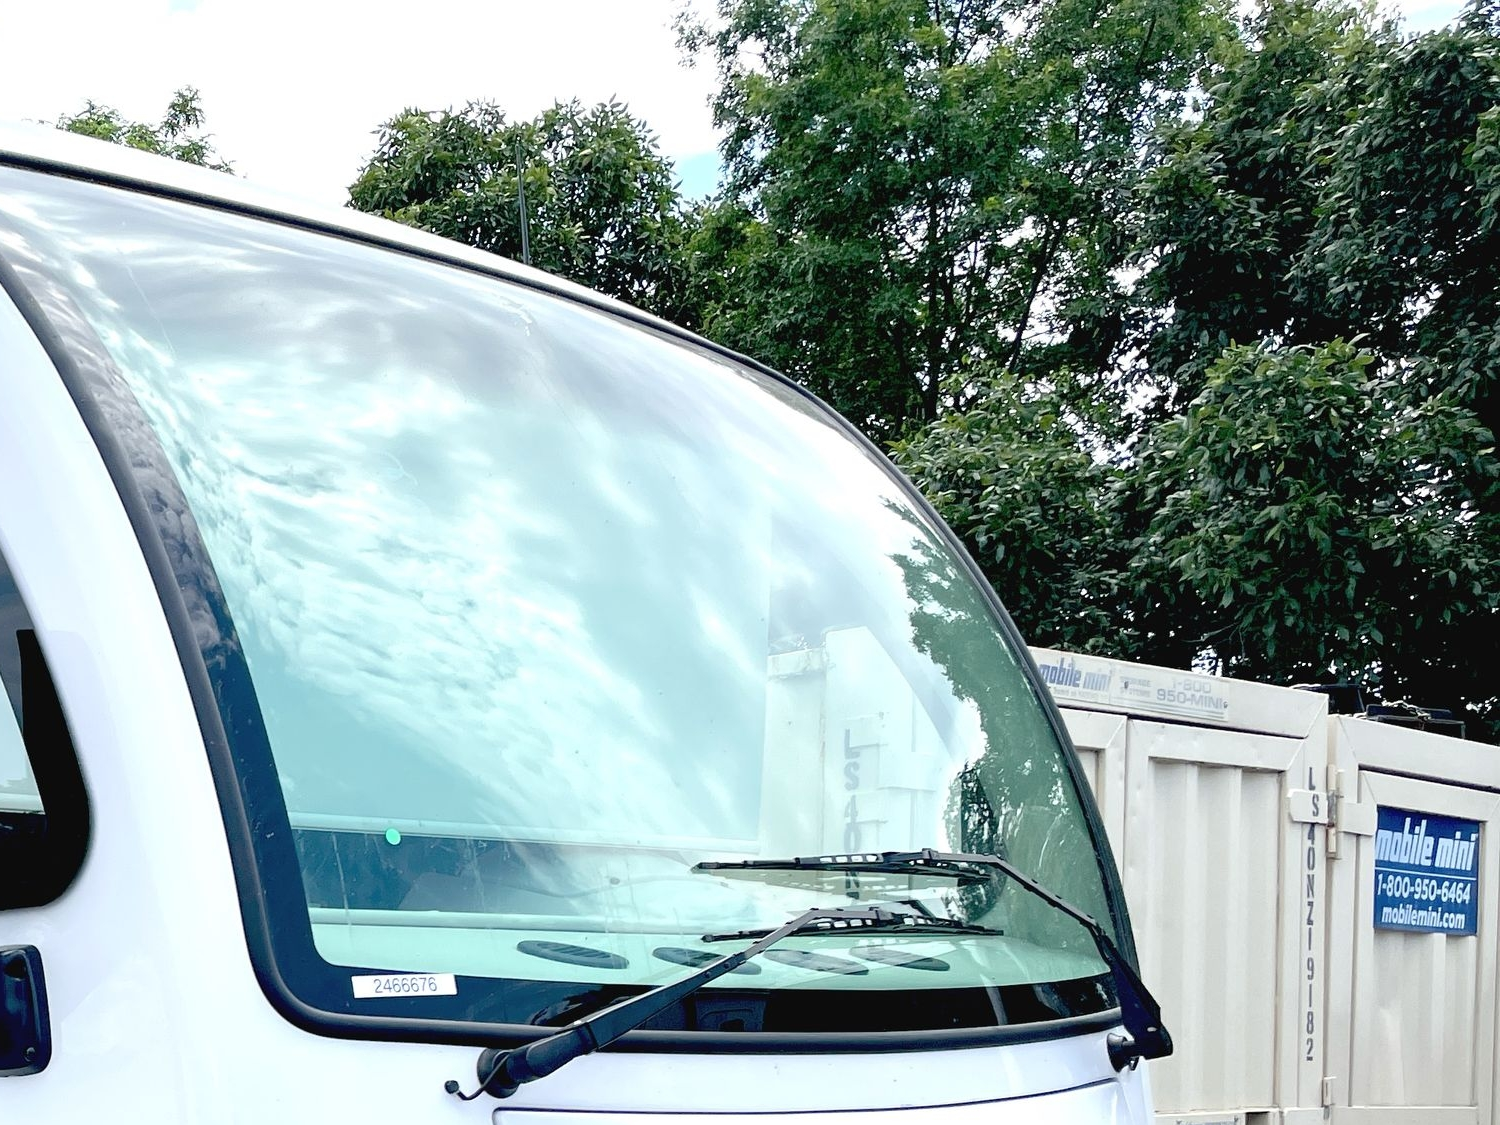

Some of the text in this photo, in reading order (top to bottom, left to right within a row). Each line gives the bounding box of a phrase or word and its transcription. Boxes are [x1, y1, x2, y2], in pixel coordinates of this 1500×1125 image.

[1039, 656, 1081, 688] mobile
[1375, 817, 1479, 871] mobile mini
[1377, 873, 1472, 905] 1-800-950-6464
[1381, 903, 1466, 930] mobilemini.com
[373, 977, 438, 994] 2466676
